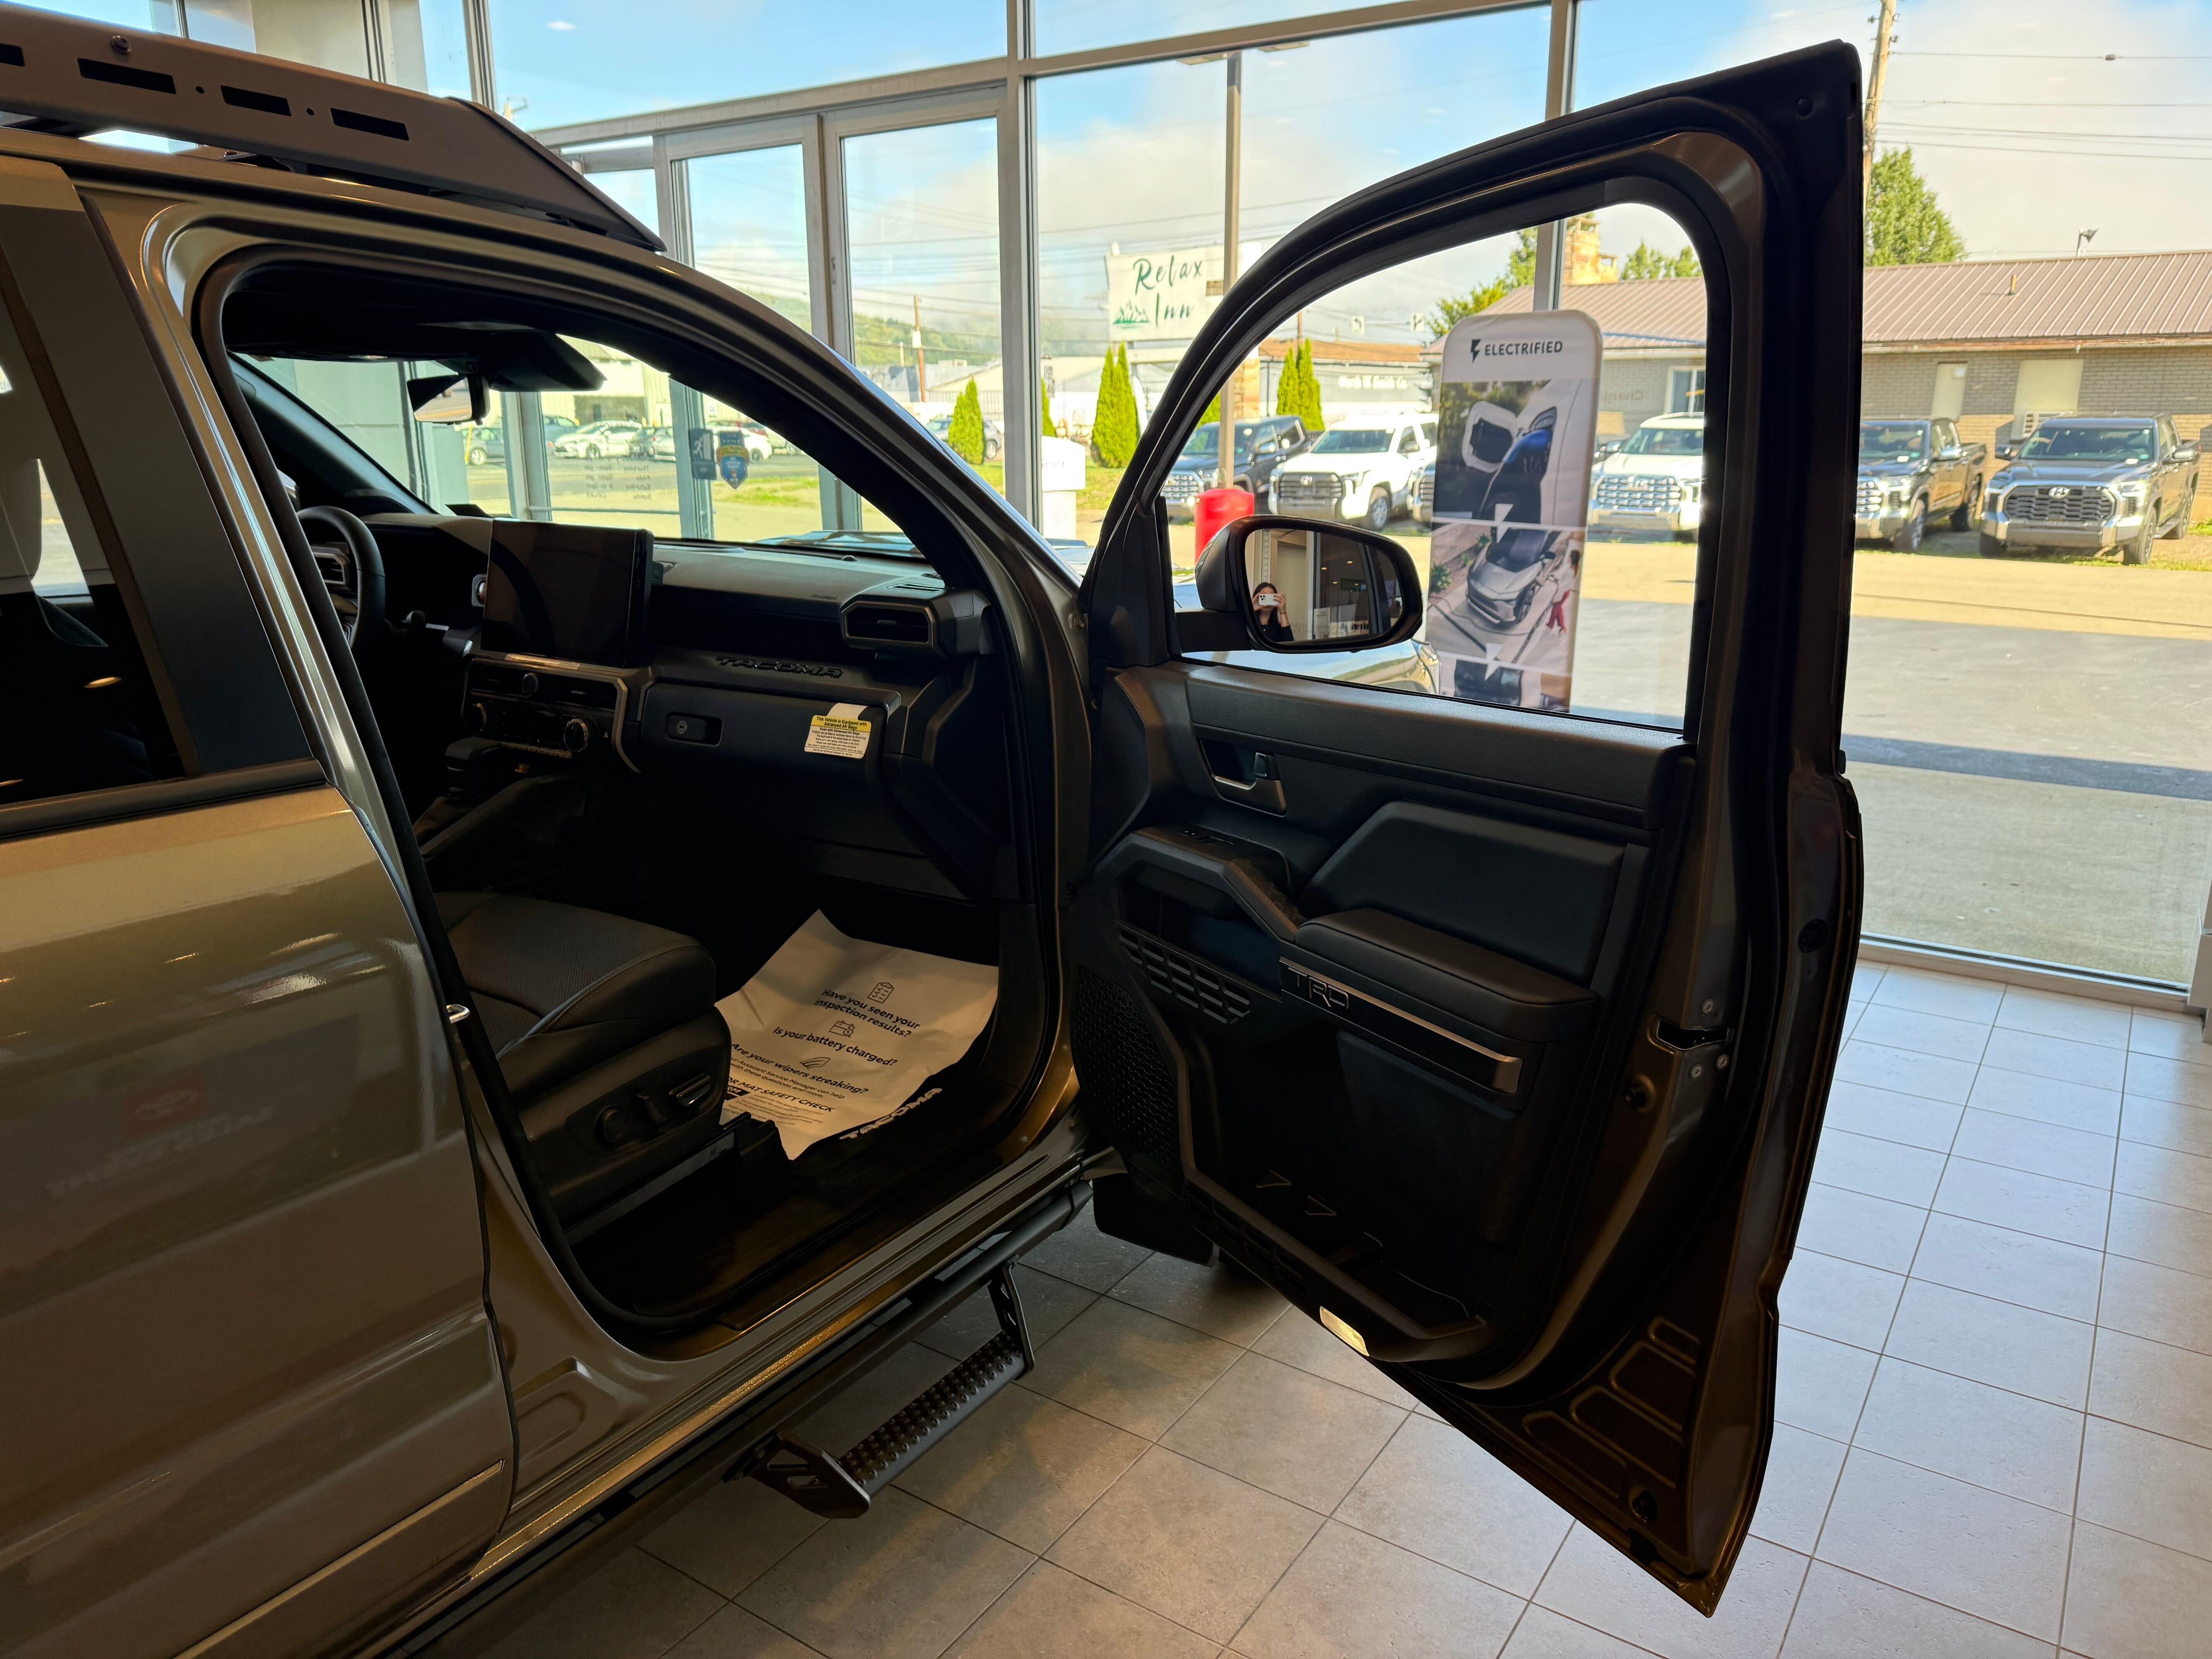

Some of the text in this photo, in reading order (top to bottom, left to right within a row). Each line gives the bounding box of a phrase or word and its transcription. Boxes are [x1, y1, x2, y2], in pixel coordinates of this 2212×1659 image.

[1133, 255, 1203, 295] Relax
[1155, 292, 1192, 328] Inn
[1485, 340, 1563, 356] ELECTRIFIED
[715, 656, 845, 678] TACOMA
[1288, 965, 1349, 1010] TRD
[814, 998, 912, 1037] inspection results?
[821, 989, 921, 1029] Have you seen your
[783, 1030, 809, 1040] your
[807, 1034, 847, 1051] battery
[846, 1046, 898, 1066] charged?
[731, 1043, 869, 1093] Are your wipers streaking?
[766, 1071, 789, 1082] Service
[788, 1079, 817, 1091] Manager
[739, 1082, 763, 1092] MAT
[761, 1089, 800, 1101] SAFETY
[799, 1099, 836, 1112] CHECK
